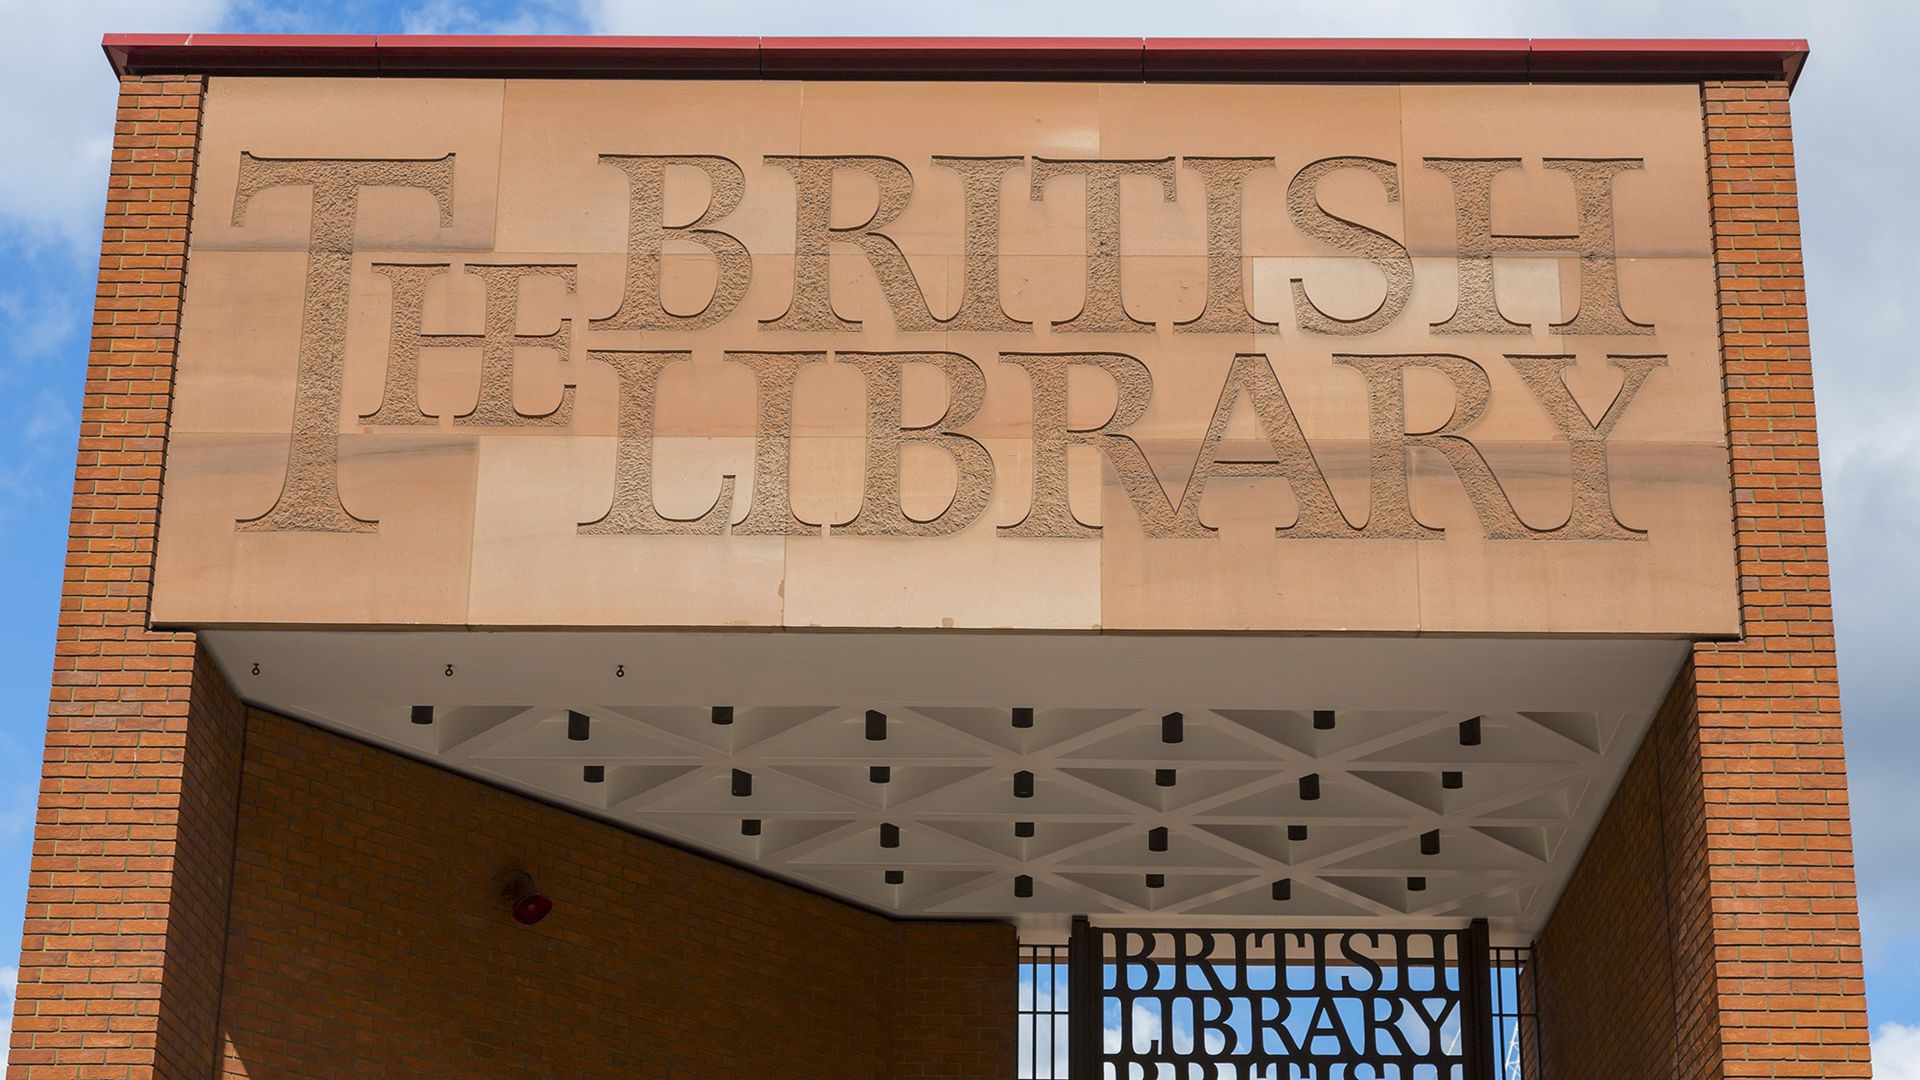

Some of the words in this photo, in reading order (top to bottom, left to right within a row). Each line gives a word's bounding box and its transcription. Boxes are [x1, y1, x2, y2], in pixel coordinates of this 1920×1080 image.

[588, 153, 1656, 336] BRITISH
[231, 151, 578, 533] THE
[577, 350, 1669, 541] LIBRARY
[1103, 929, 1463, 995] BRITISH
[1103, 995, 1463, 1060] LIBRARY
